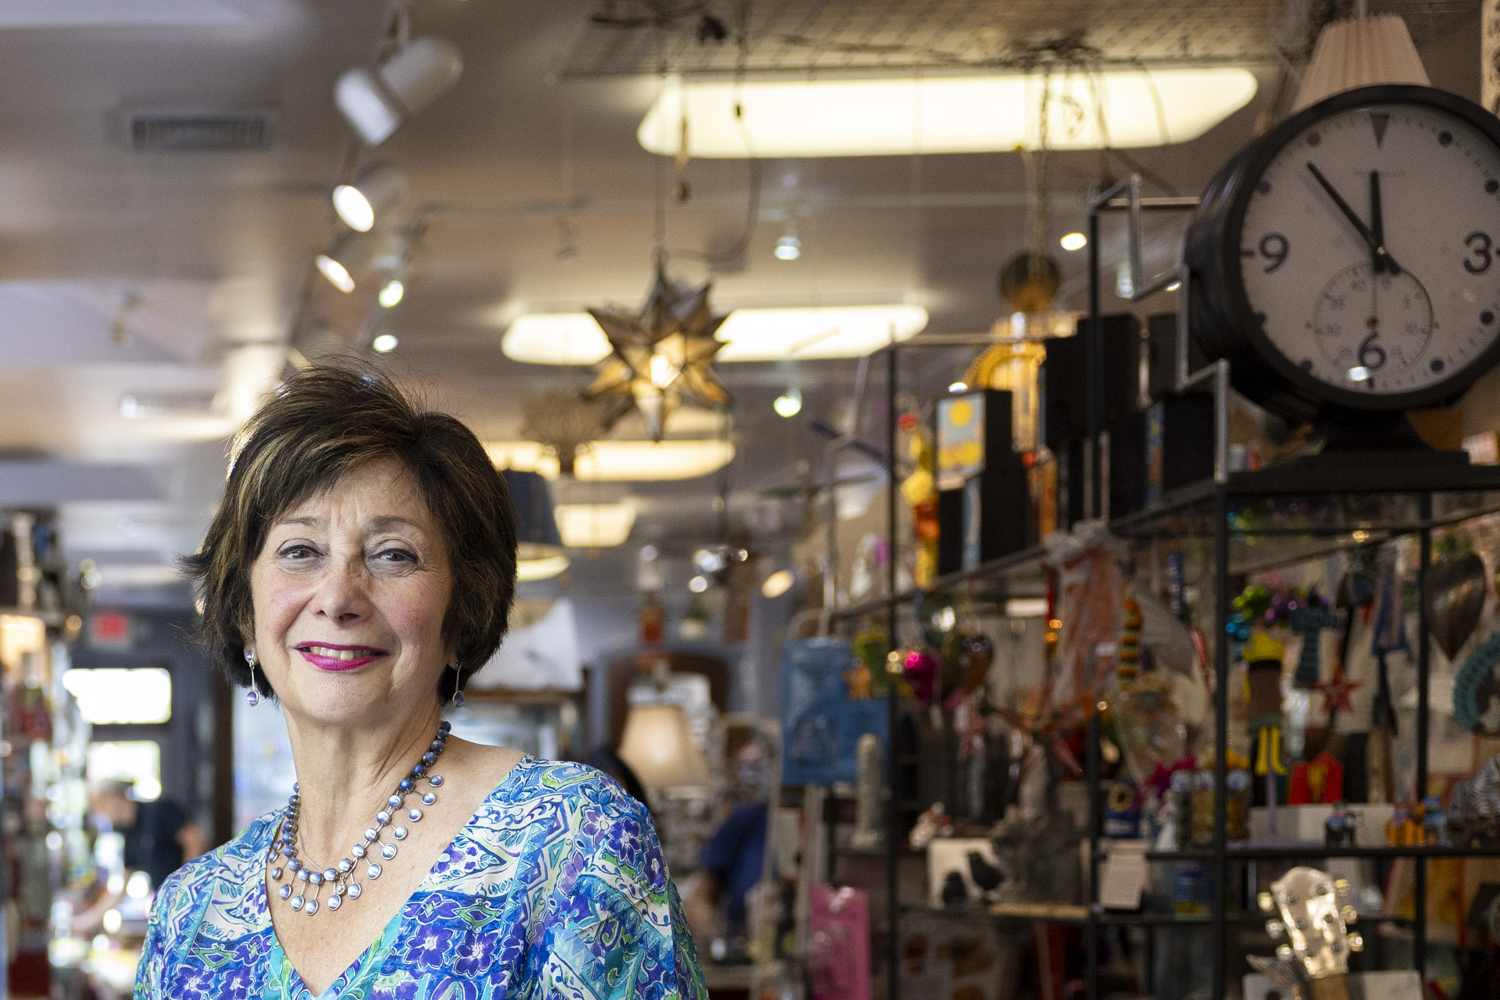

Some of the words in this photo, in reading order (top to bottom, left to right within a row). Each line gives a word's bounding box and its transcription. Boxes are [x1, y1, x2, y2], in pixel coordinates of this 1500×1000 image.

[1258, 232, 1290, 273] 9
[1463, 231, 1492, 274] 3
[1358, 332, 1386, 371] 6
